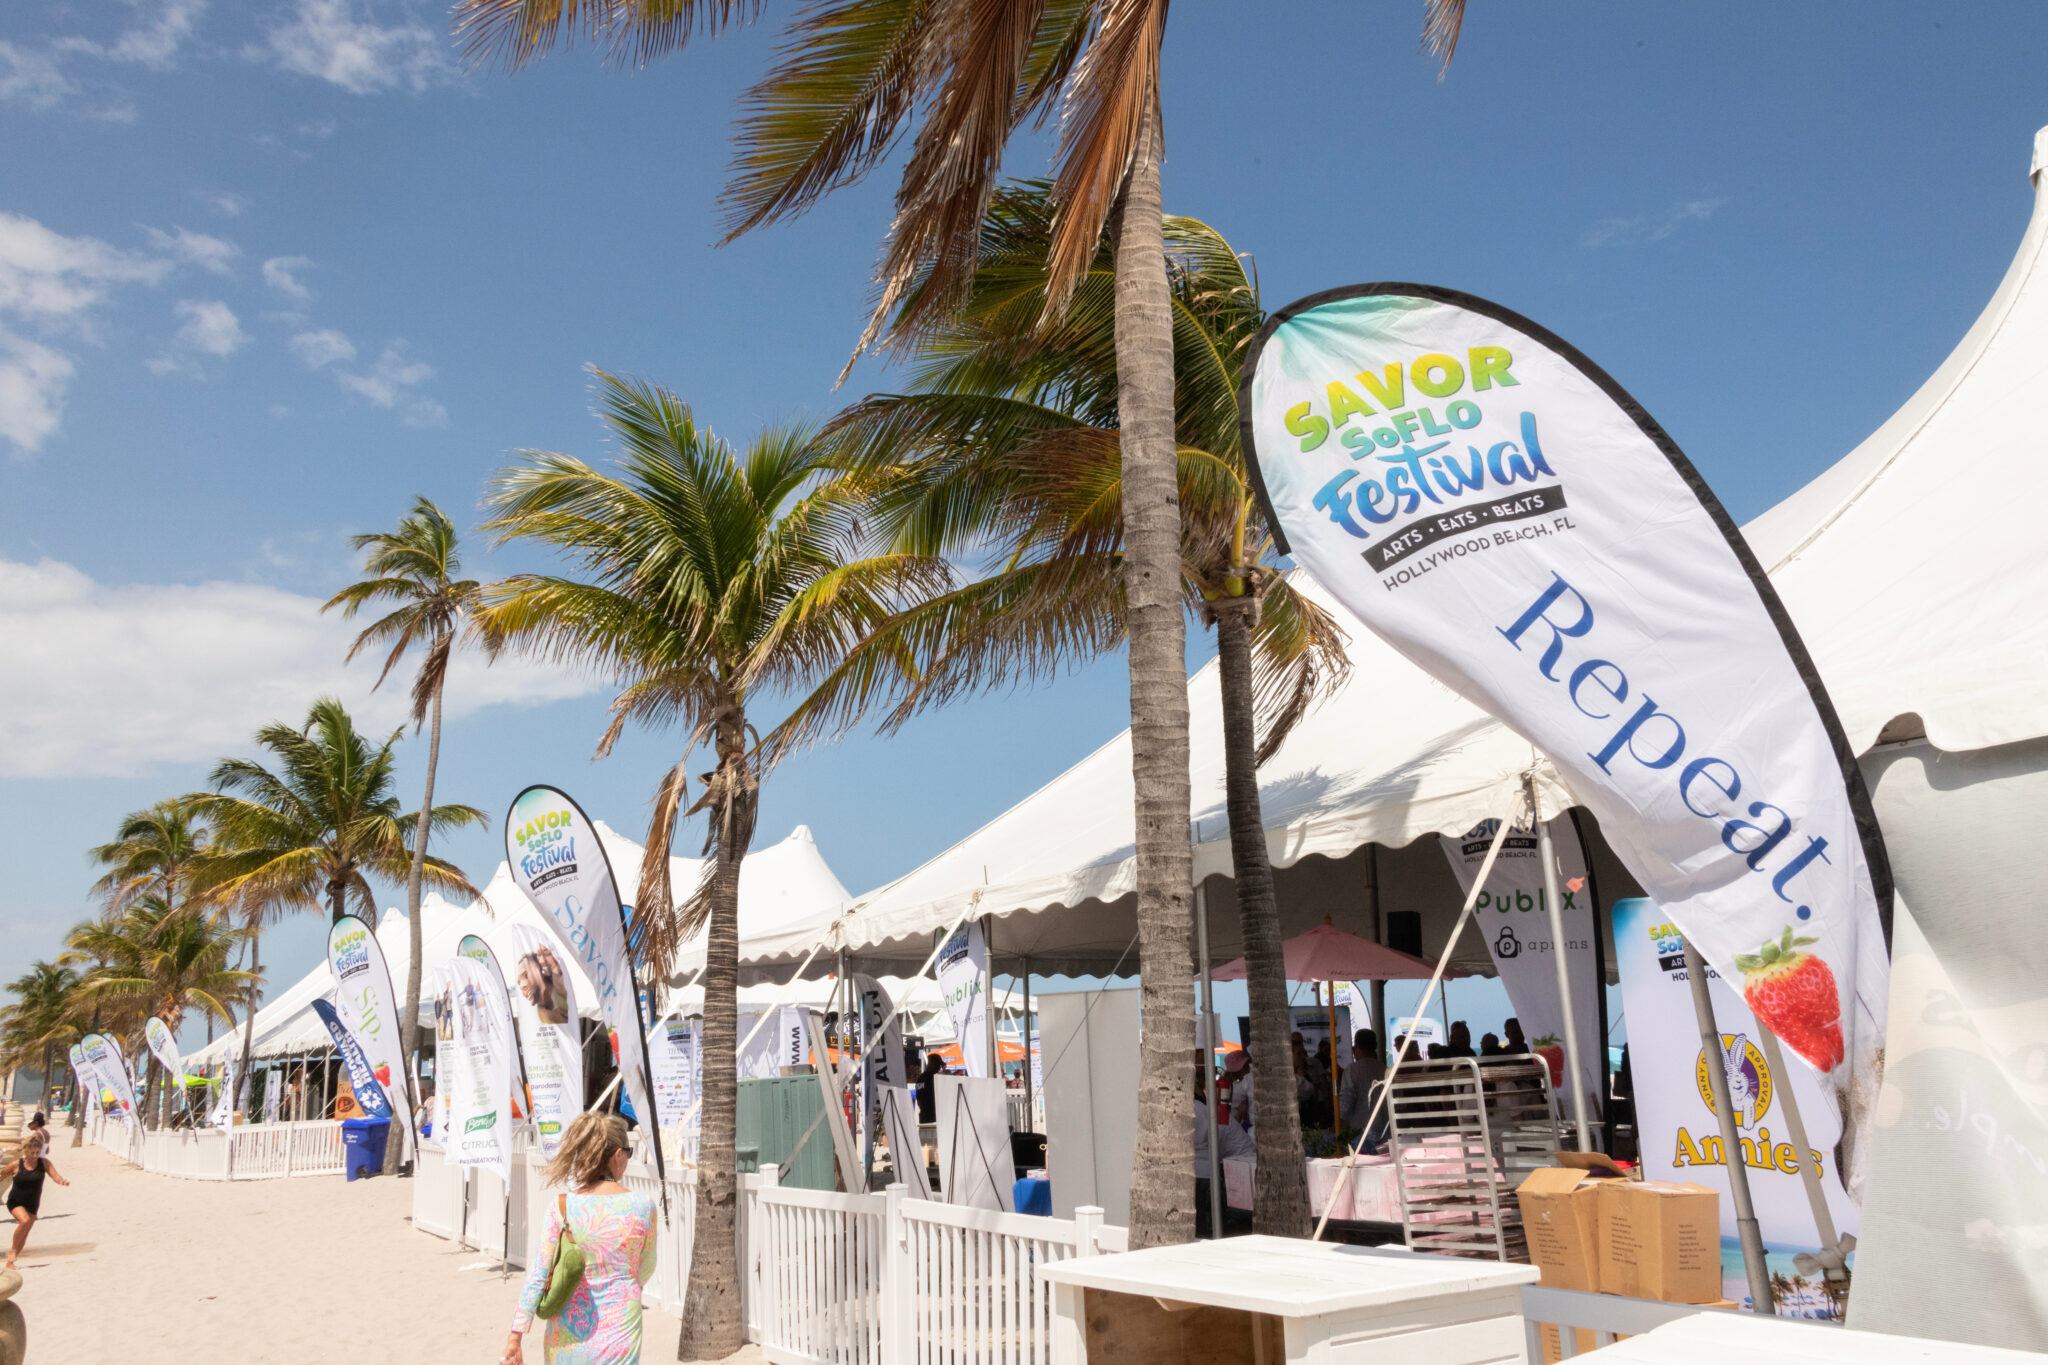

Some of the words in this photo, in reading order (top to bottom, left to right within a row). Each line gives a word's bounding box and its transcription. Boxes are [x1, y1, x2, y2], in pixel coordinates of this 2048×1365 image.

[1284, 346, 1520, 453] SAVOR
[1312, 411, 1557, 539] Festival
[1382, 529, 1423, 561] ARTS
[1440, 511, 1477, 532] EATS
[1492, 495, 1545, 517] BEATS
[1382, 537, 1490, 591] HOLLYWOOD
[1495, 523, 1553, 546] BEACH,
[1556, 516, 1576, 531] FL
[1495, 570, 1833, 921] Repeat.
[516, 810, 572, 847] SAVOR
[520, 836, 577, 879] Festival
[1475, 888, 1576, 914] Publx
[333, 930, 366, 953] SAVOR
[1648, 922, 1681, 940] SAV
[336, 946, 369, 973] Festival
[1671, 957, 1687, 967] ART
[1323, 982, 1350, 994] SVOR
[1748, 1050, 1768, 1109] APPROVAL
